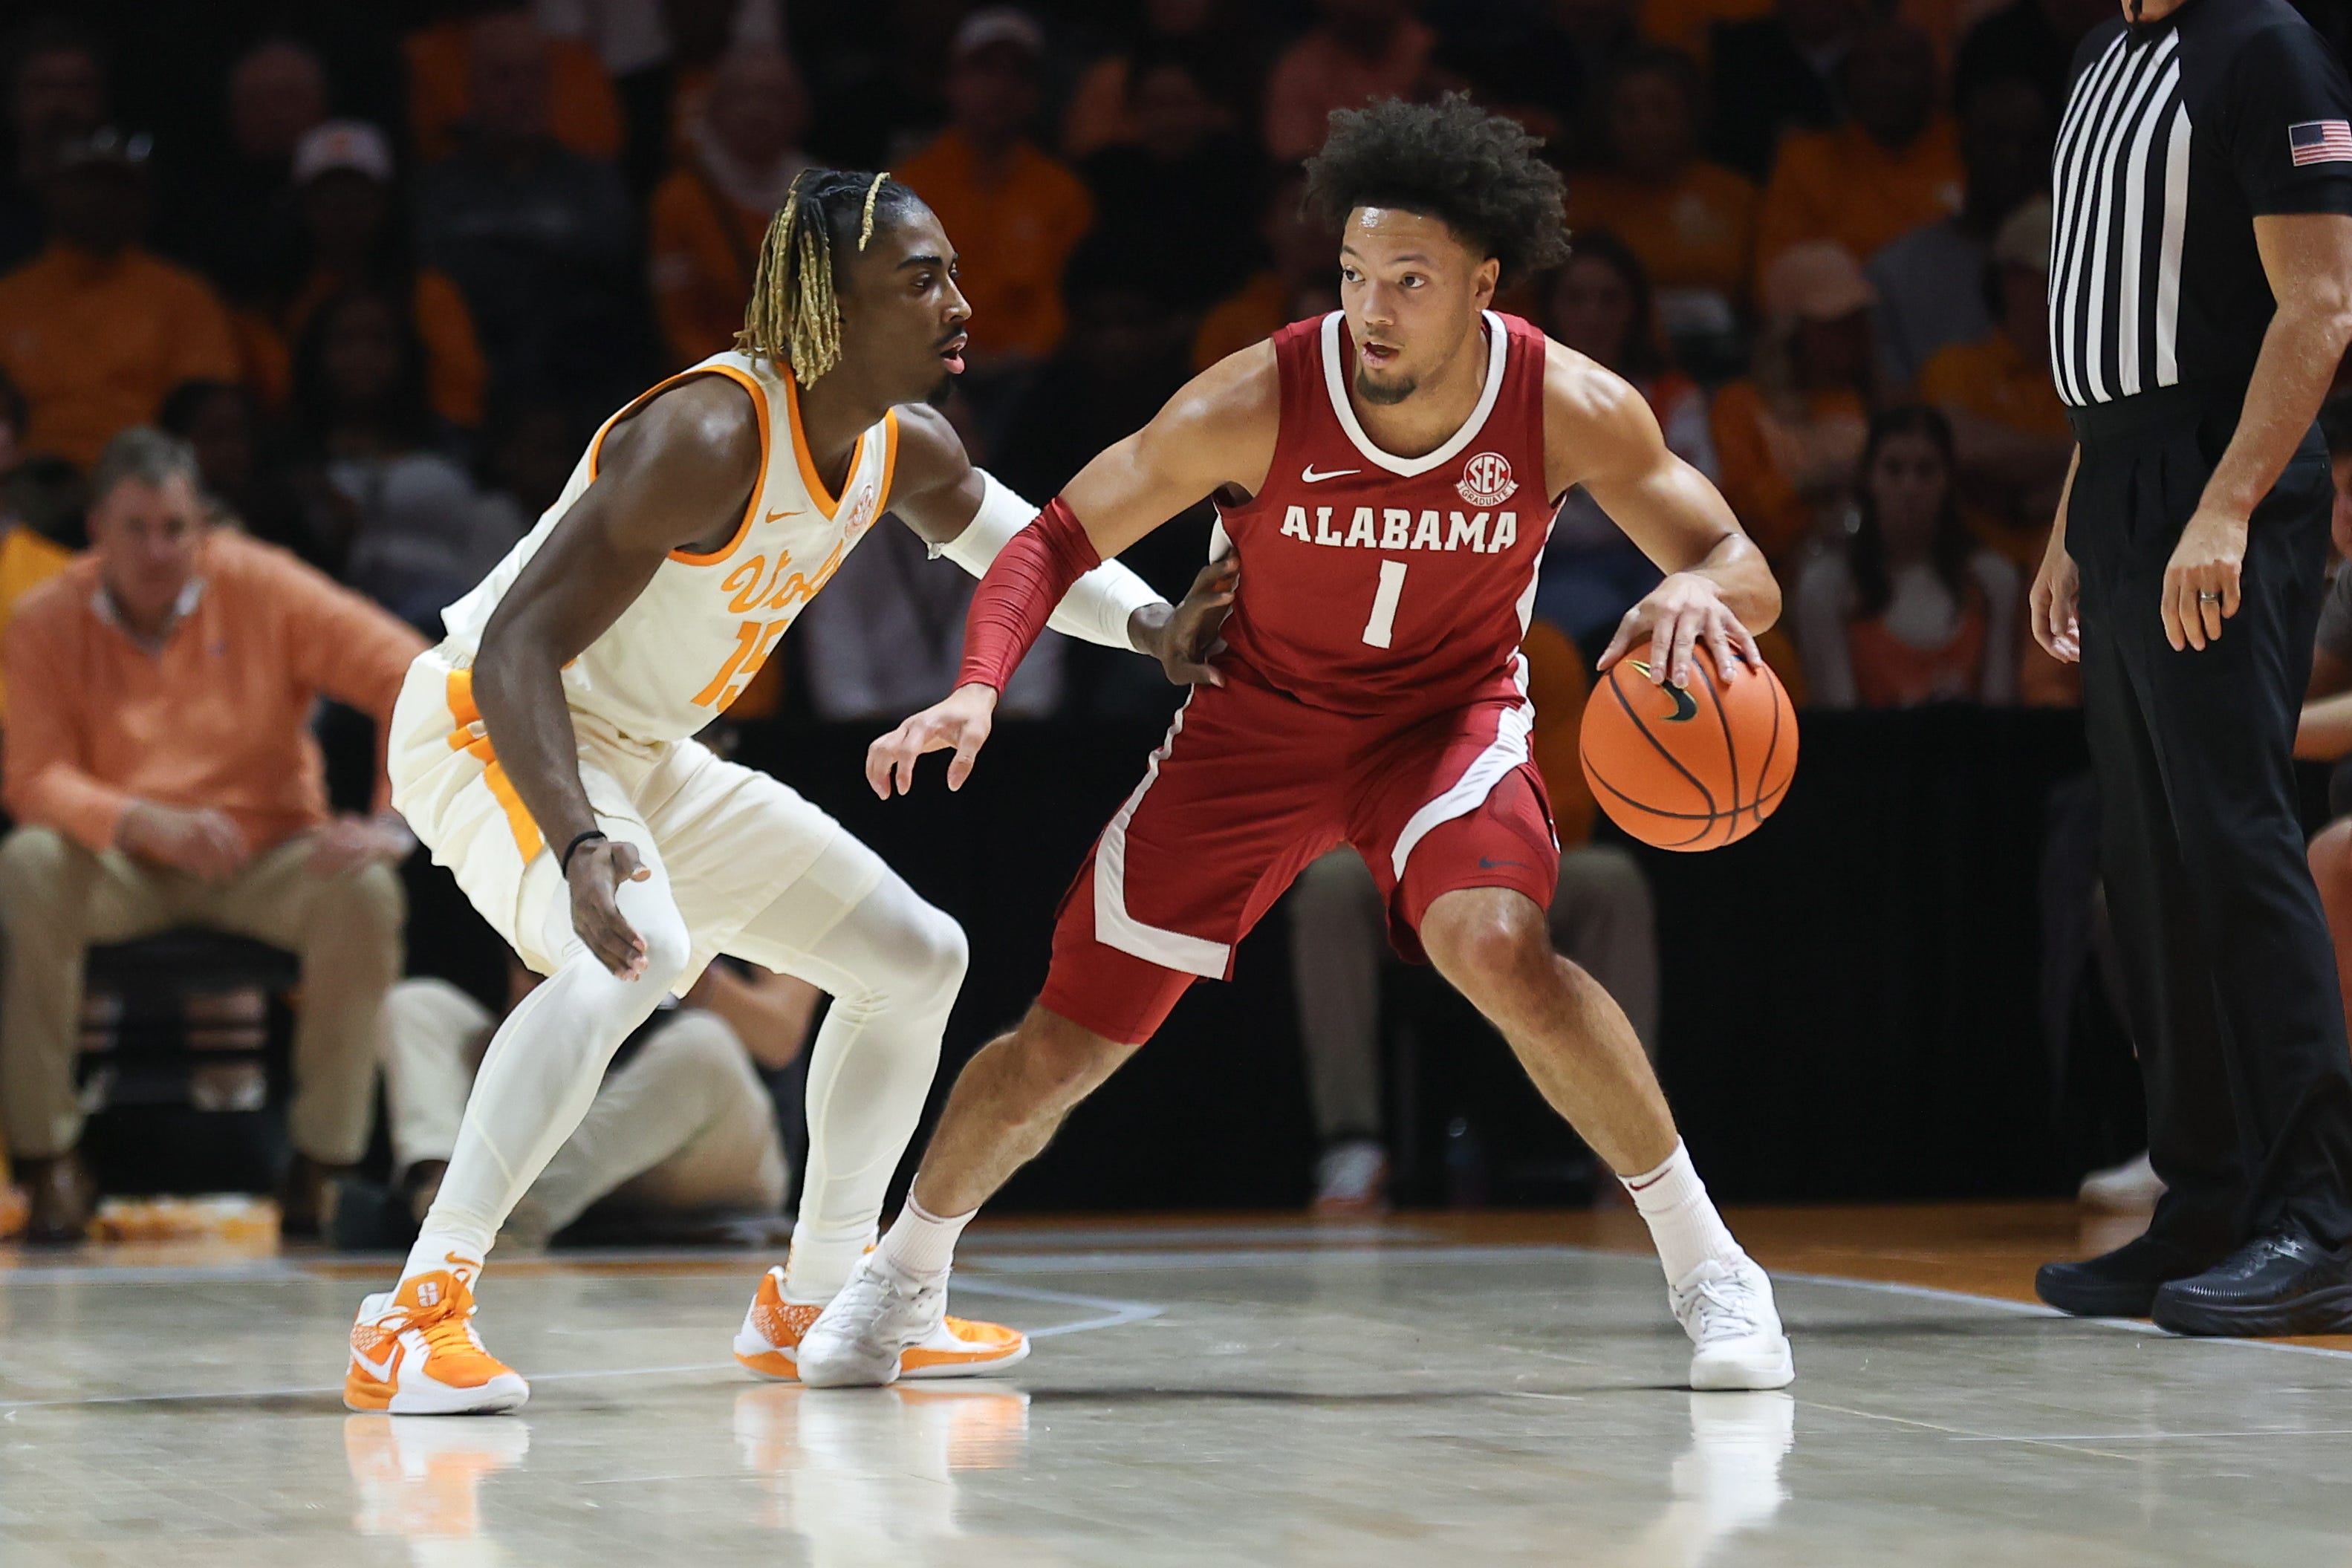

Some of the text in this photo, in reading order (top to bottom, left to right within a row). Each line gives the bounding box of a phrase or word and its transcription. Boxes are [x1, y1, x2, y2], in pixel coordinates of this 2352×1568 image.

[1461, 489, 1510, 506] GRADUATE
[1469, 455, 1507, 493] SEC
[1280, 505, 1517, 553] ALABAMA
[1362, 559, 1408, 648] 1
[689, 618, 790, 713] 15
